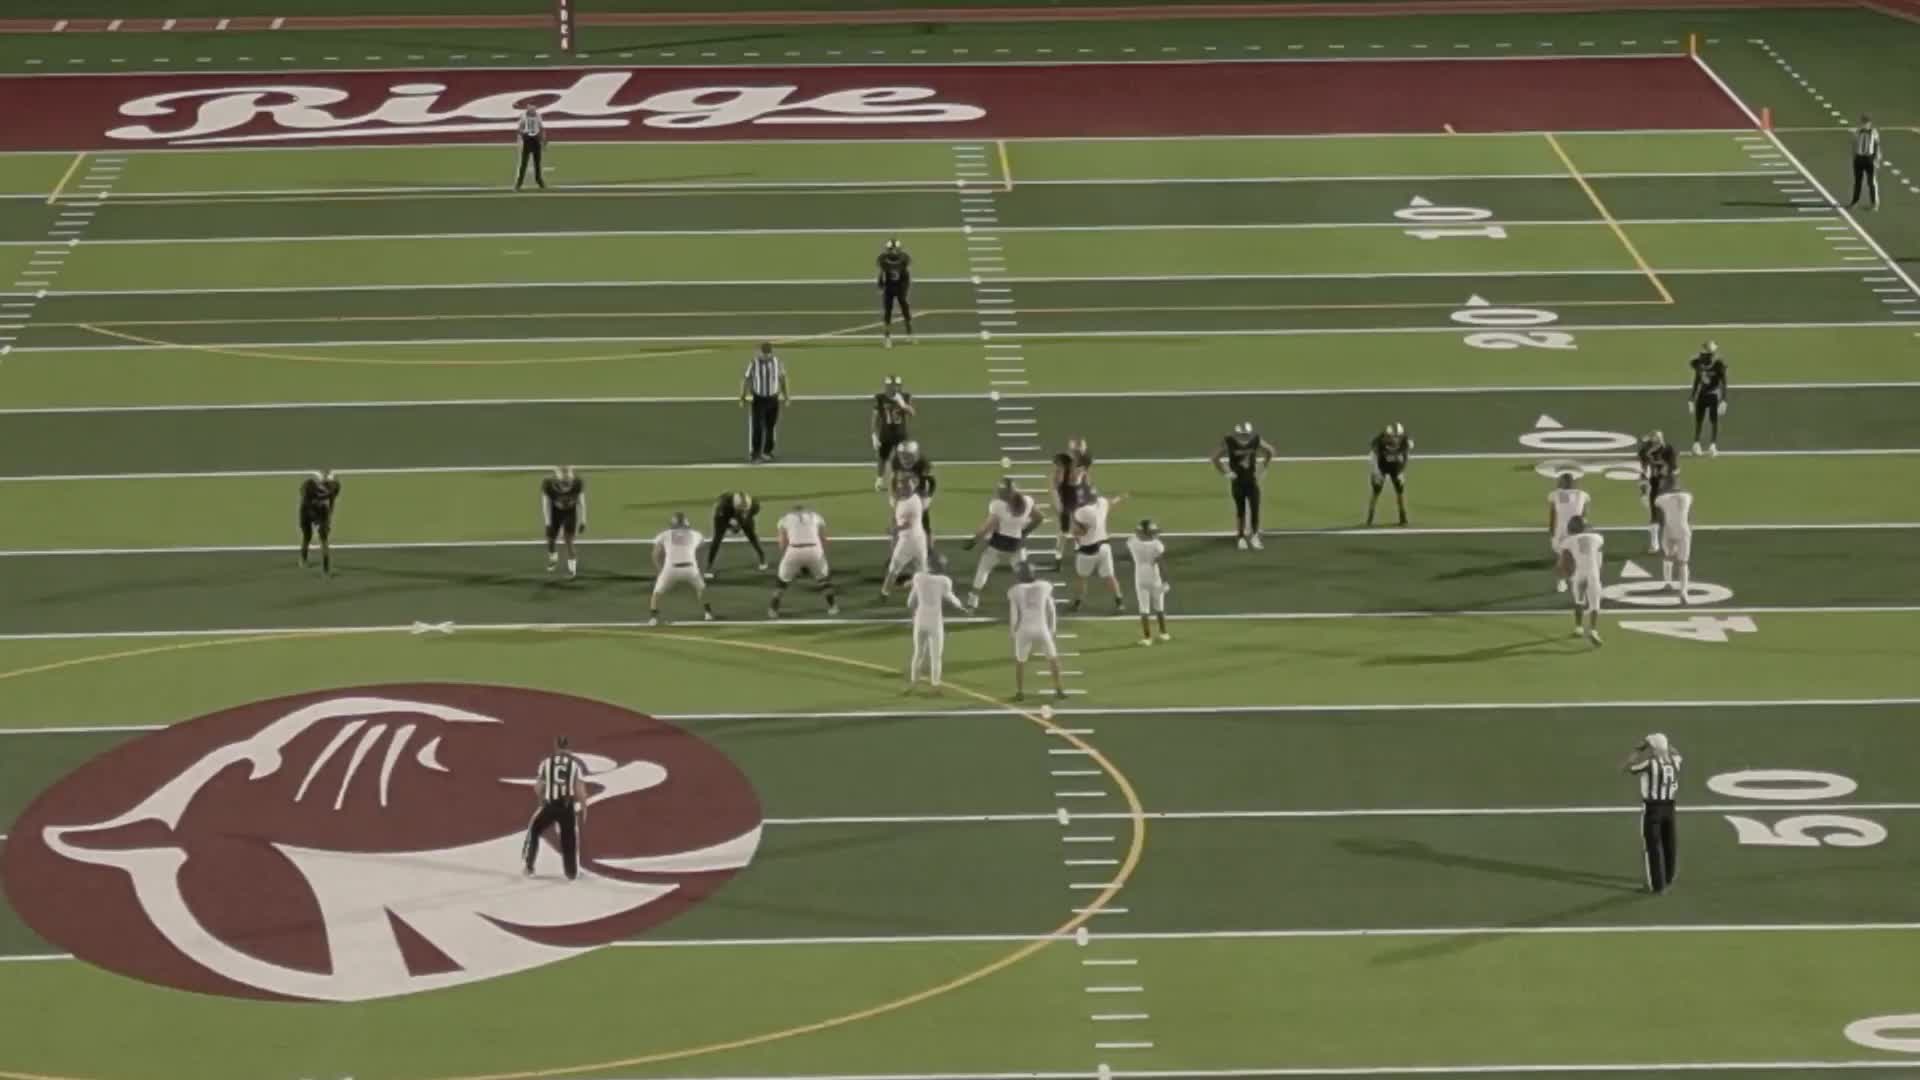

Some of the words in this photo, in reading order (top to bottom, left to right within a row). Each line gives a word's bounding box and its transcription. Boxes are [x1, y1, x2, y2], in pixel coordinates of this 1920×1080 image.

[105, 72, 986, 143] Ridge
[1393, 207, 1507, 239] 10
[1450, 308, 1577, 349] 20
[1519, 430, 1652, 480] 30
[1601, 580, 1758, 642] 40
[554, 765, 567, 783] C
[1706, 769, 1888, 847] 50
